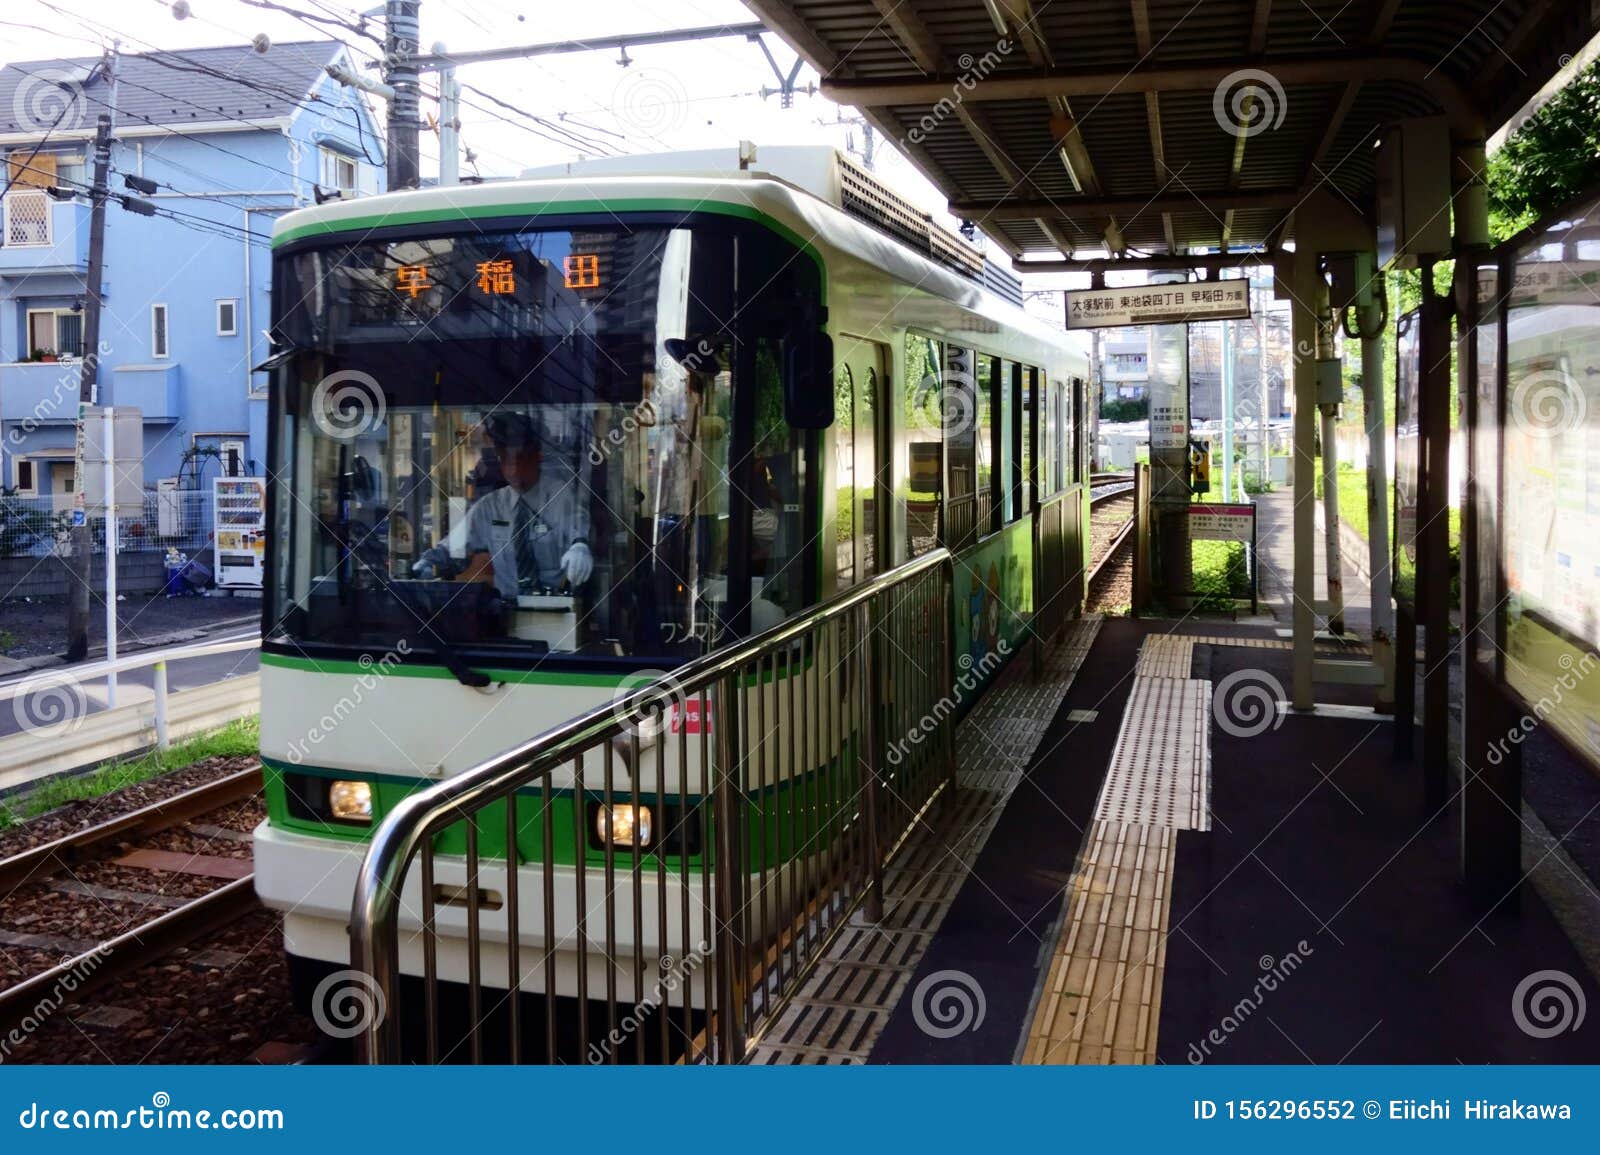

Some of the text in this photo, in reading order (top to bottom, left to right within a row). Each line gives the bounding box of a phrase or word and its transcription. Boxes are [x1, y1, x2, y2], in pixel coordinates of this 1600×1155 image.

[1072, 298, 1114, 312] 大塚駅前
[1120, 292, 1185, 308] 東池袋四丁目
[660, 622, 726, 643] ワンマン
